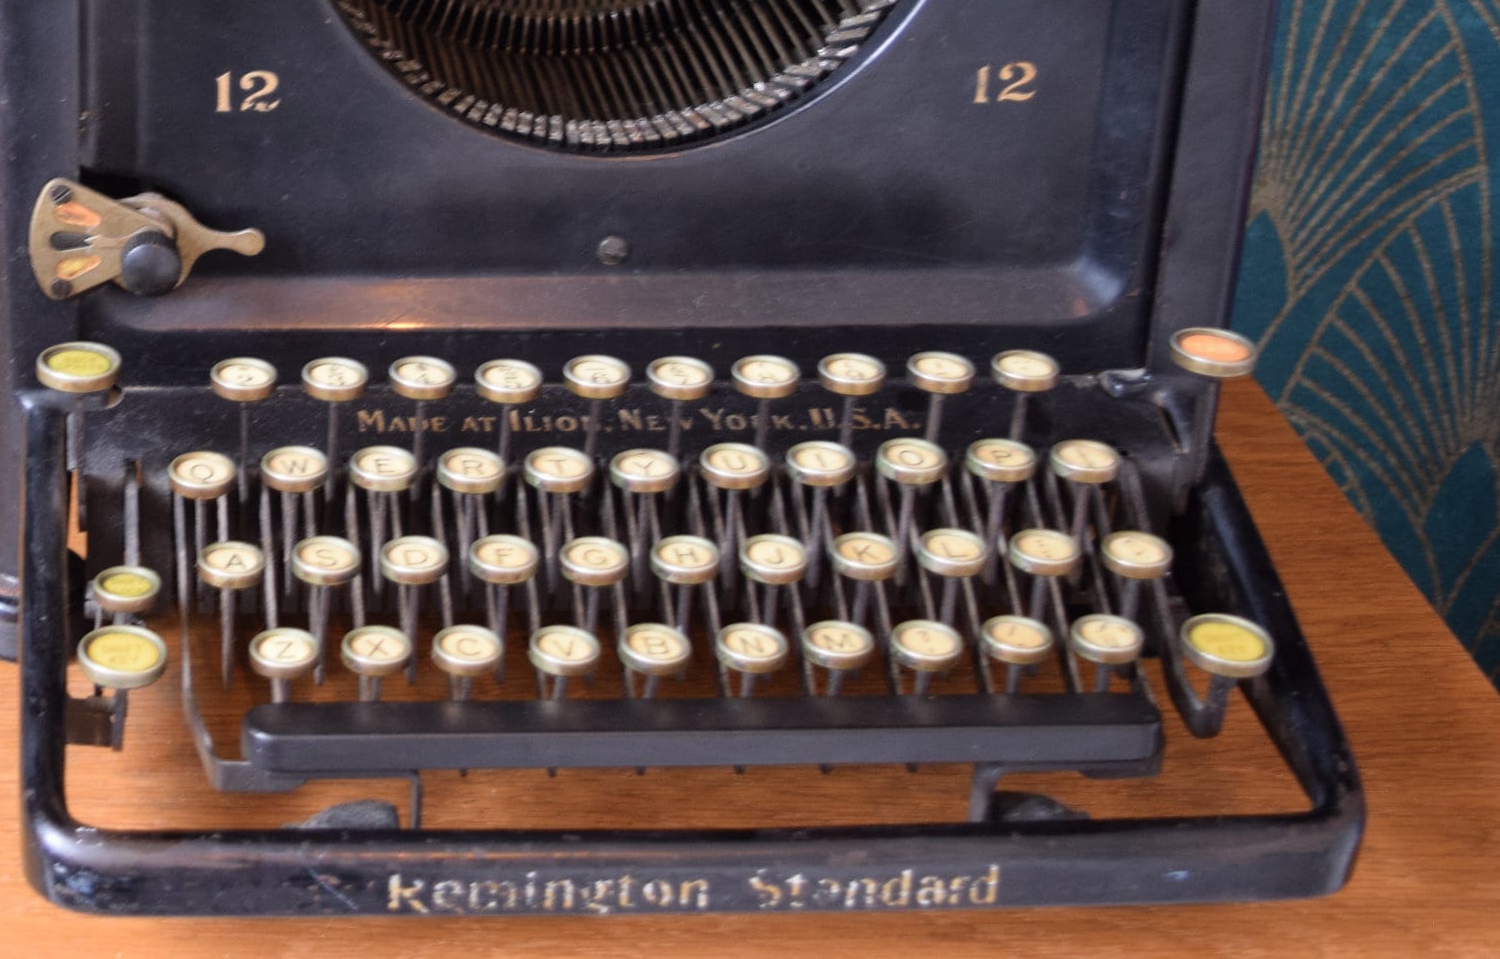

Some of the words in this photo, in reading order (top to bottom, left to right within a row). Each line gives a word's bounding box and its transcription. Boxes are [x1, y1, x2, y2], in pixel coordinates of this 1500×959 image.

[215, 70, 281, 112] 12
[973, 61, 1037, 103] 12
[189, 463, 213, 484] Q
[280, 458, 308, 474] W
[374, 458, 395, 474] E
[461, 459, 483, 475] R
[547, 458, 566, 474] T
[639, 460, 655, 475] Y
[721, 455, 747, 470] U
[900, 450, 923, 465] O
[225, 554, 246, 570] A
[313, 548, 335, 566] S
[403, 549, 427, 566] D
[494, 548, 515, 564] F
[582, 548, 607, 566] G
[673, 547, 698, 564] H
[764, 548, 784, 565] J
[851, 545, 877, 561] K
[940, 542, 969, 559] L
[275, 642, 295, 658] Z
[365, 640, 390, 657] X
[455, 637, 480, 655] C
[552, 641, 575, 656] V
[644, 636, 669, 655] B
[739, 636, 764, 654] N
[821, 633, 849, 650] M
